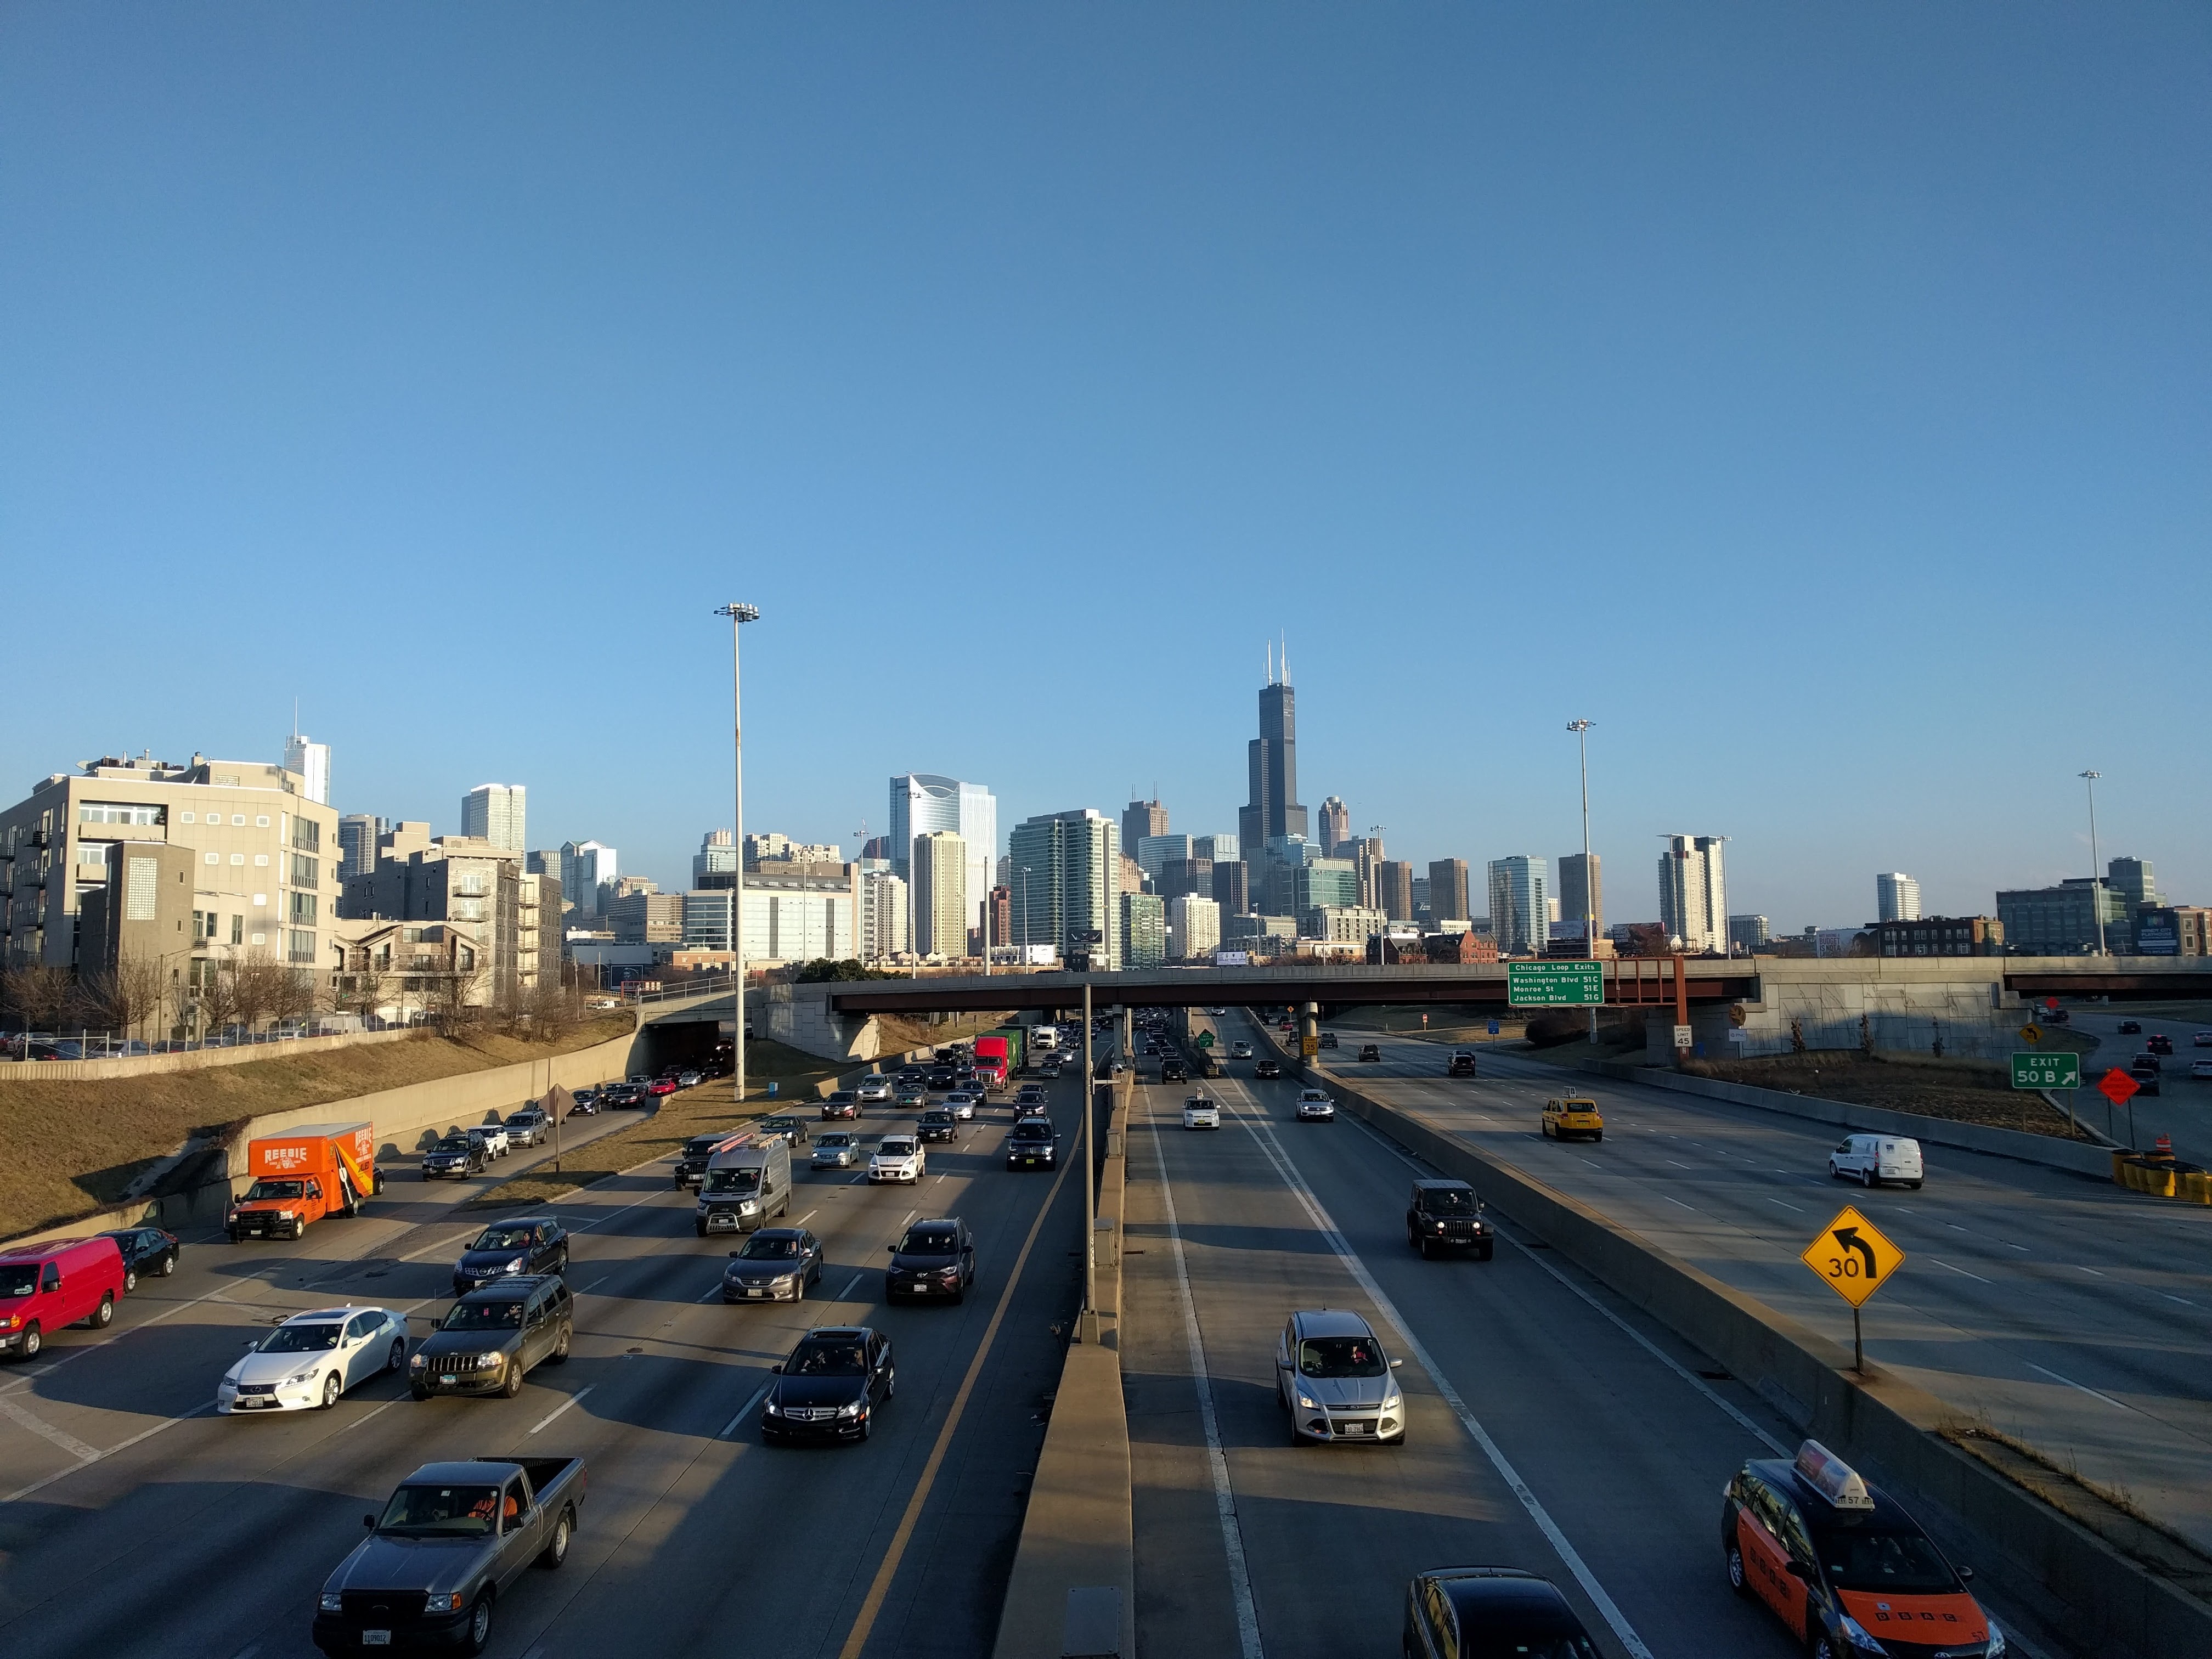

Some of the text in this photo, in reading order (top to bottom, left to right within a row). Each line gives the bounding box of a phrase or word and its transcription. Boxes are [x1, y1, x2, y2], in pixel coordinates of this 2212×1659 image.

[1513, 977, 1558, 985] Washington
[2030, 1058, 2060, 1066] EXIT
[2017, 1070, 2056, 1082] 50 B
[355, 1127, 372, 1150] REEBIE
[264, 1147, 307, 1164] REEBIE
[1828, 1258, 1859, 1278] 30
[1848, 1496, 1859, 1504] 57
[1971, 1631, 1985, 1640] 57
